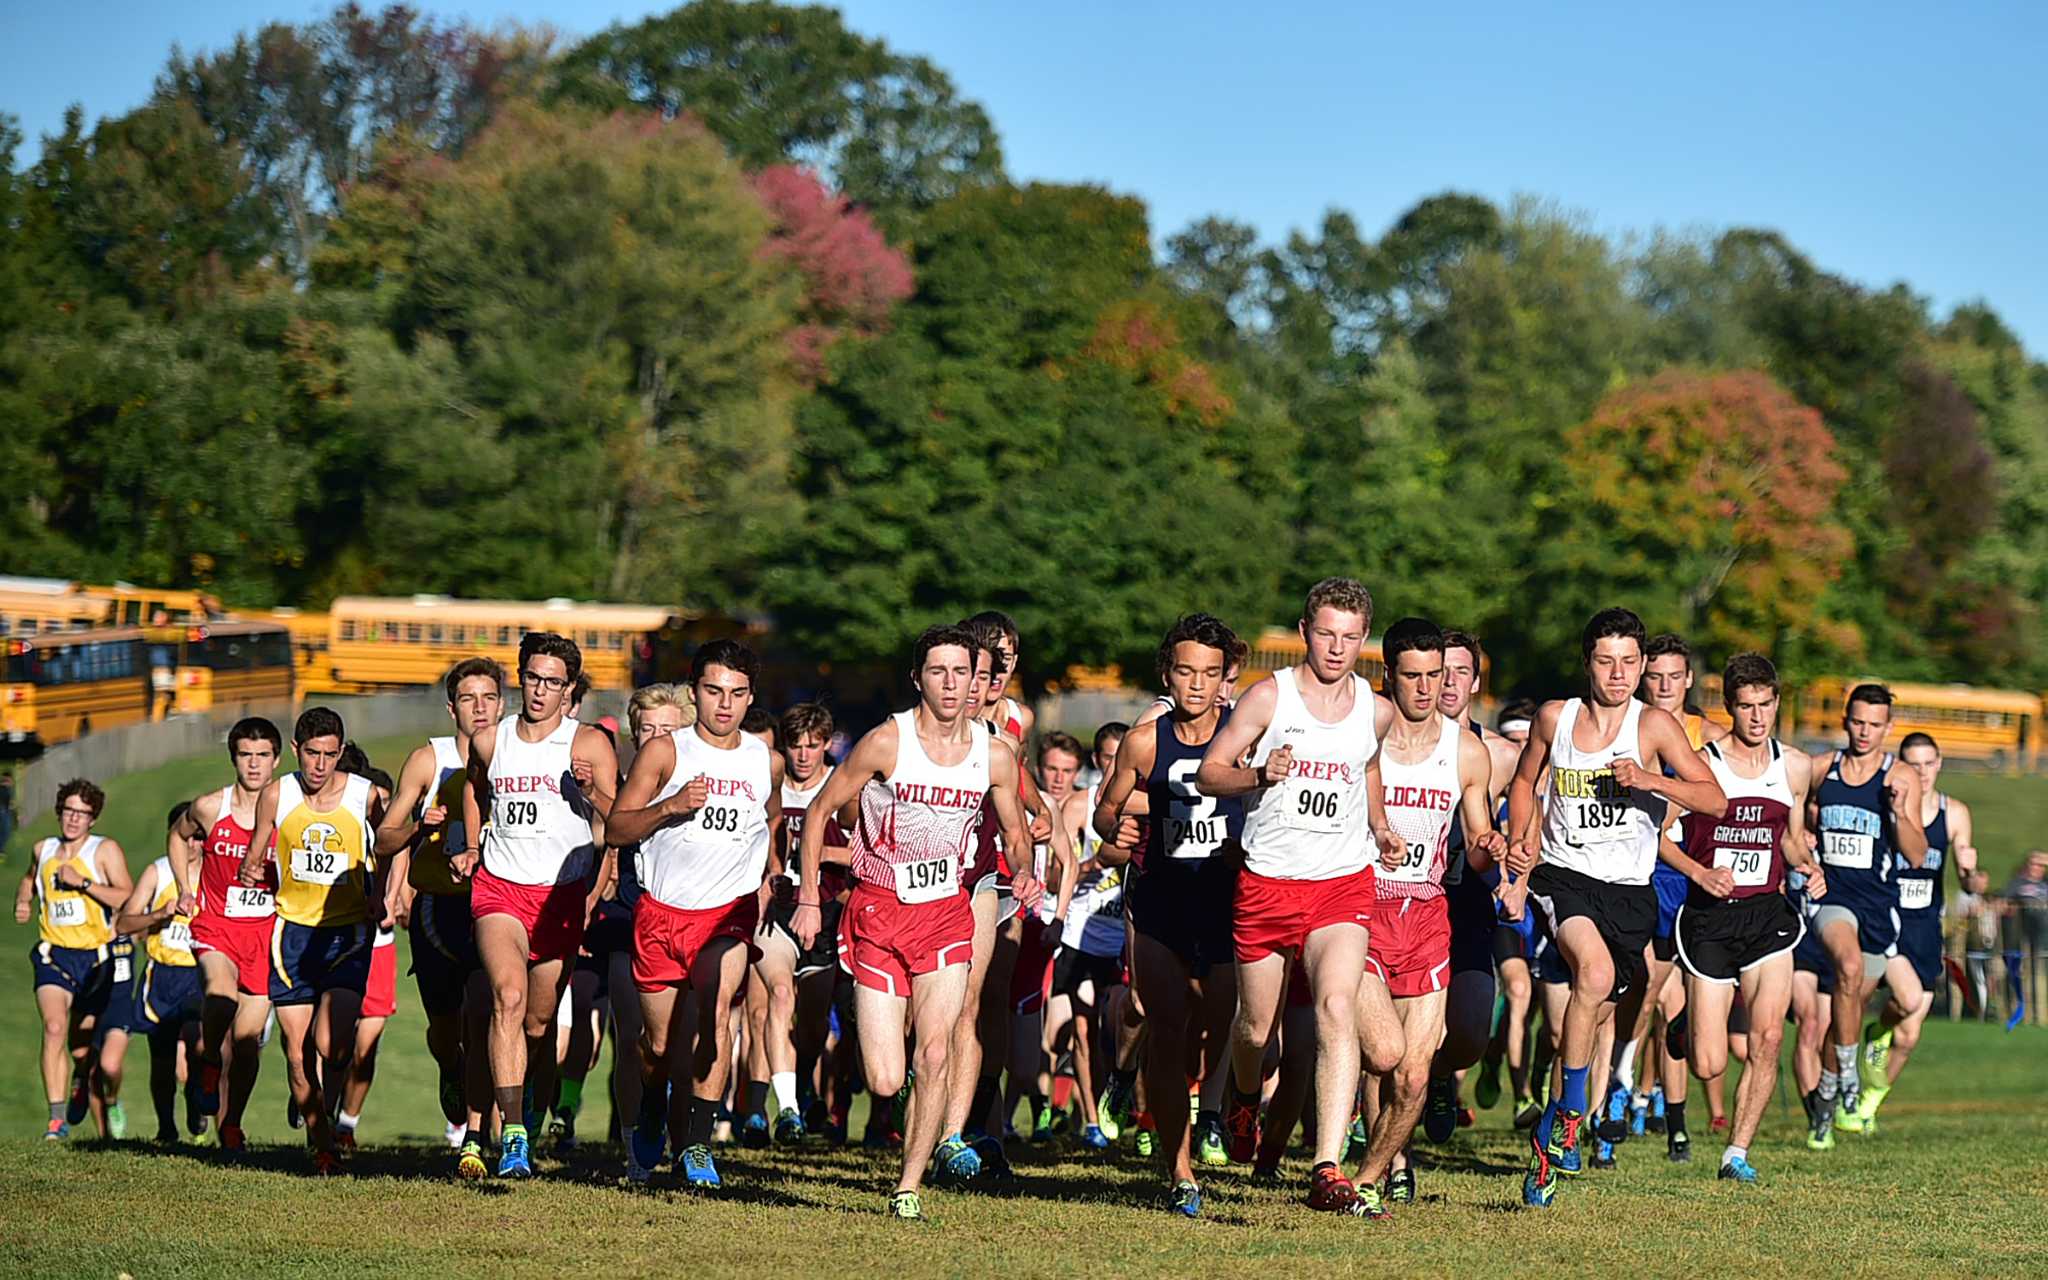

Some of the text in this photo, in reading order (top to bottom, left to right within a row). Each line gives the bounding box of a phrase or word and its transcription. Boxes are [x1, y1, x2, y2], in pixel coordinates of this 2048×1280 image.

[495, 775, 542, 794] PREP
[696, 775, 740, 796] REP
[895, 782, 982, 809] WILDCATS
[507, 801, 538, 825] 879
[1298, 789, 1339, 818] 906
[1577, 802, 1627, 829] 1892
[1736, 806, 1763, 822] EAST
[702, 806, 738, 832] 893
[1820, 804, 1881, 839] NORTH
[1172, 820, 1218, 844] 2401
[1831, 836, 1862, 856] 1651
[305, 853, 334, 874] 182
[906, 859, 948, 889] 1979
[1731, 851, 1760, 873] 750
[239, 889, 266, 906] 426
